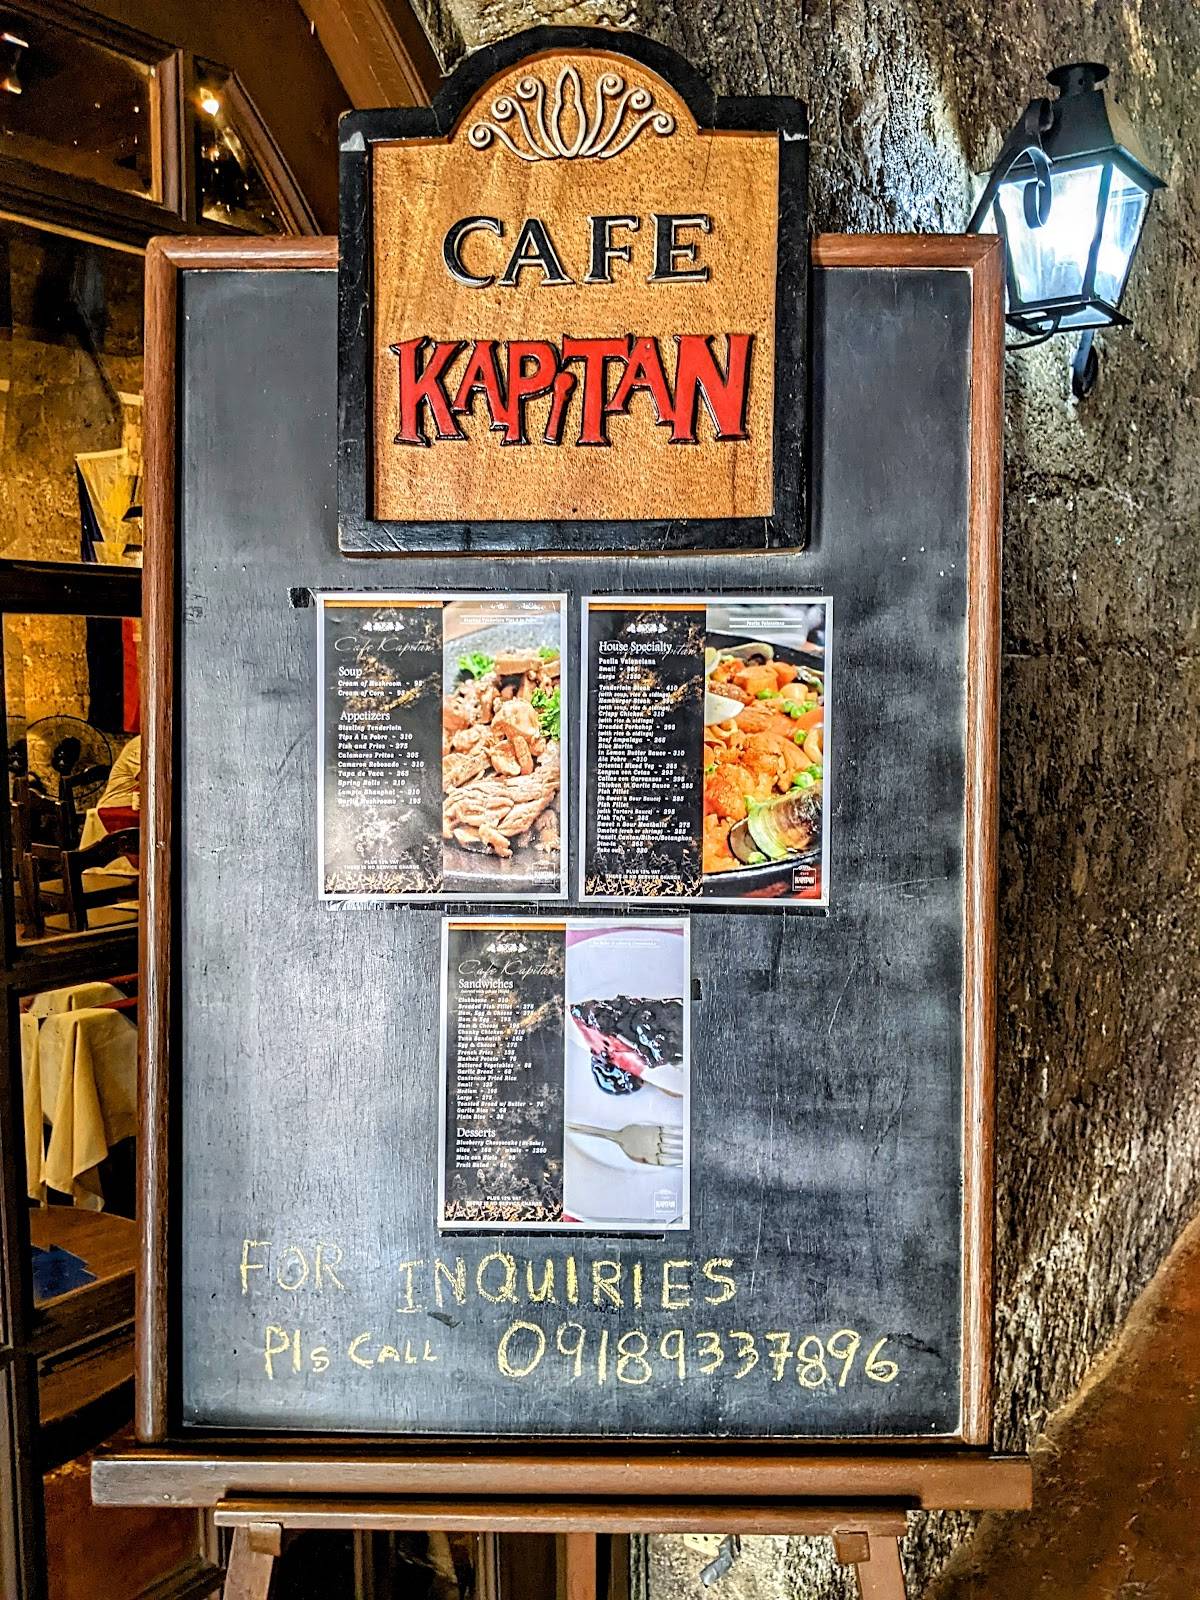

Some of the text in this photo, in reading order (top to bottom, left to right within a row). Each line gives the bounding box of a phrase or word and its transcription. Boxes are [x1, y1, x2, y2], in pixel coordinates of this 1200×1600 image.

[442, 213, 712, 287] CAFE
[599, 640, 628, 652] House
[631, 641, 672, 654] Specialty
[339, 666, 362, 678] Soup
[340, 711, 390, 722] Appetizers
[459, 979, 513, 988] Sandwiches
[457, 1128, 496, 1137] Desserts
[239, 1240, 737, 1313] FOR INQUIRIES
[498, 1320, 898, 1388] 09189337896
